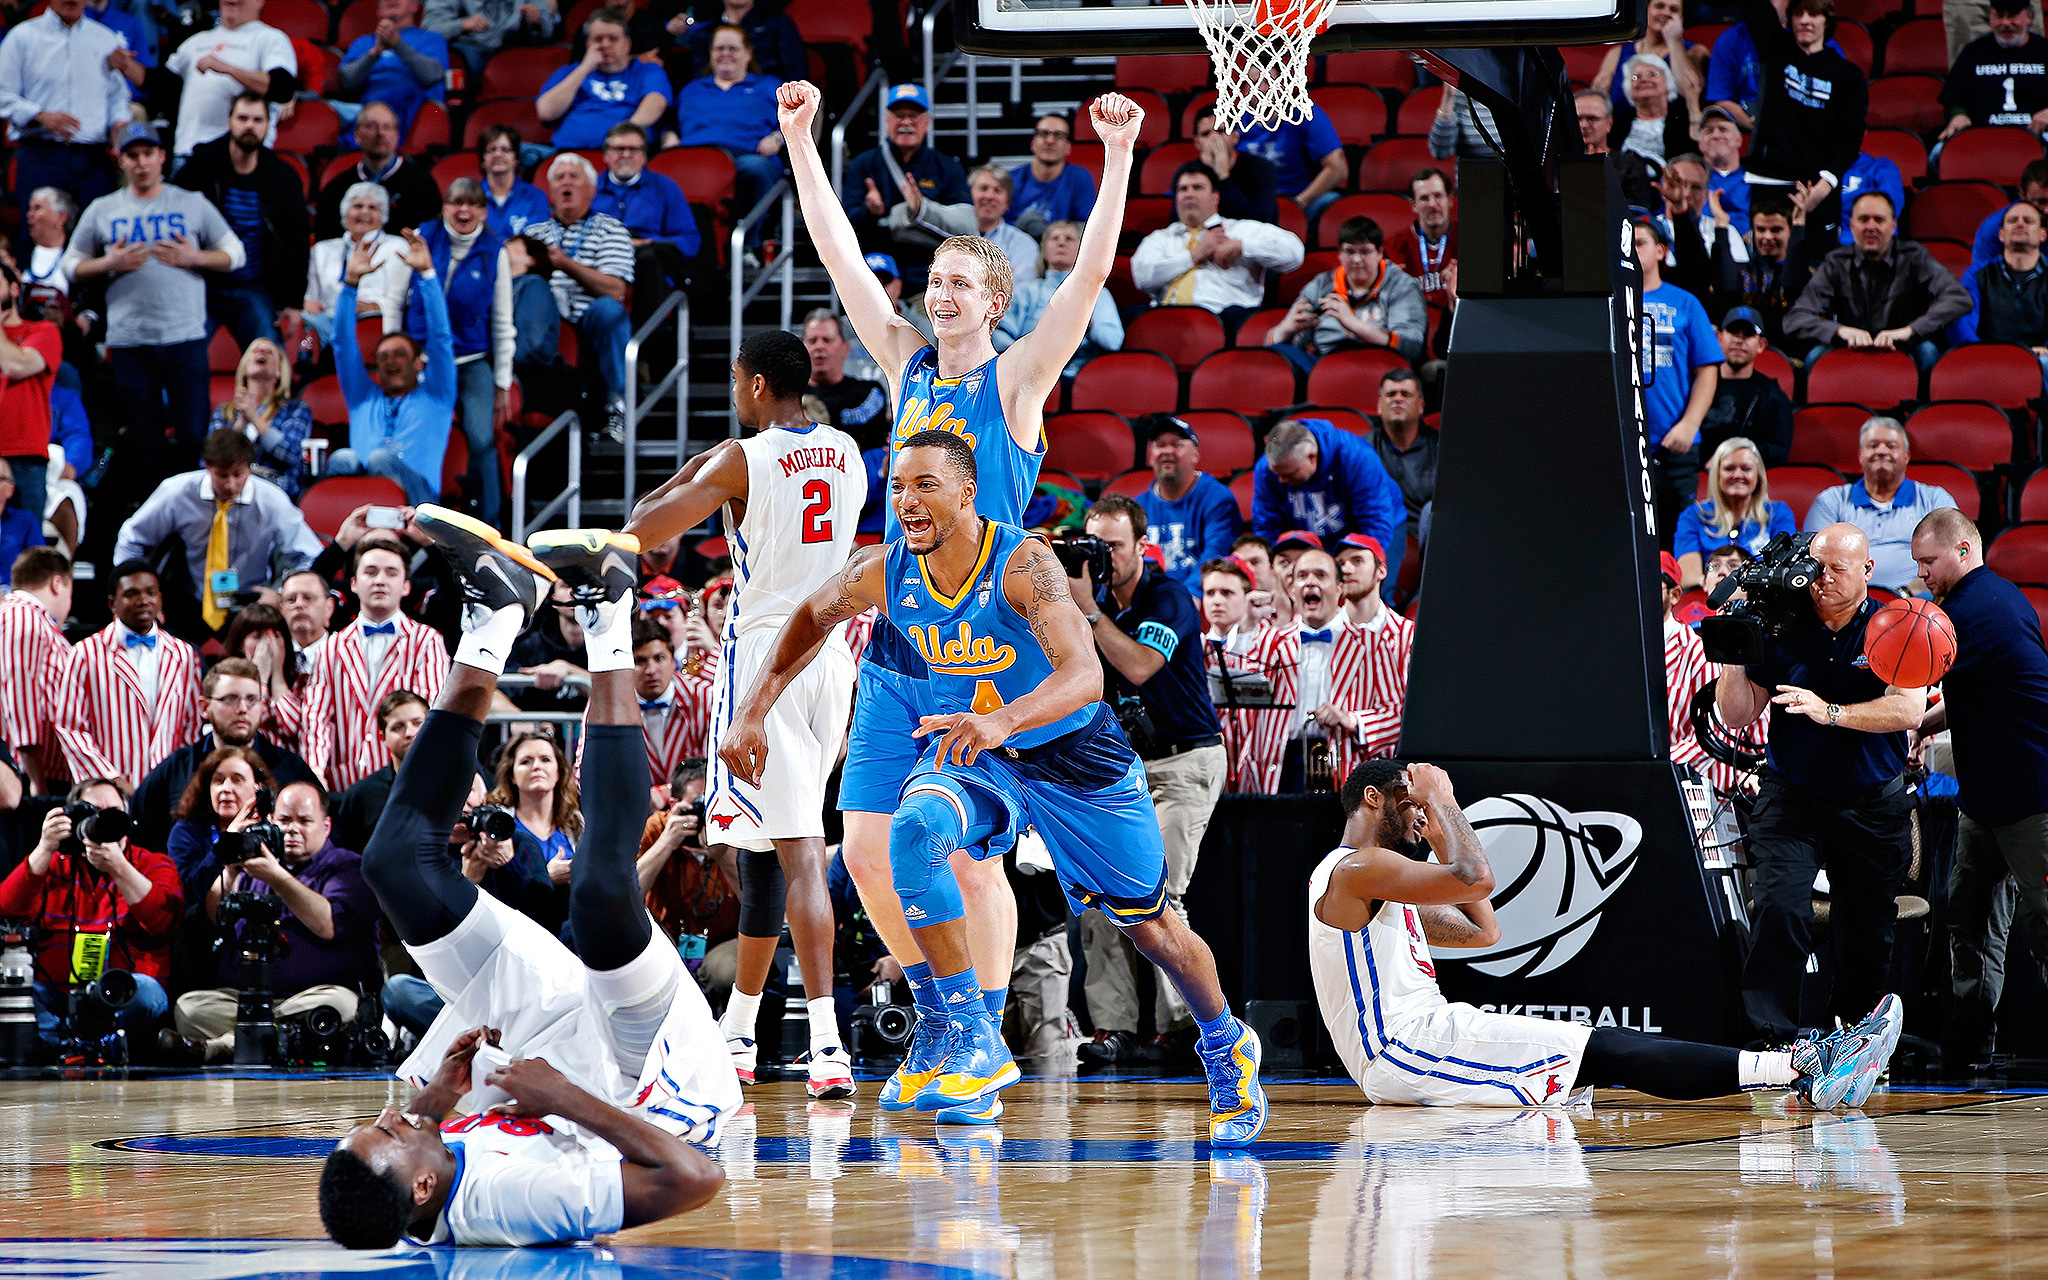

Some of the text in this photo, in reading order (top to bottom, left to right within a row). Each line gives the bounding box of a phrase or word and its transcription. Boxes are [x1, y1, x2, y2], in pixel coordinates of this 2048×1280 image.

[1975, 63, 2046, 76] UTAH STATE
[2002, 77, 2018, 111] 1
[112, 213, 185, 244] CATS
[777, 447, 846, 479] MOREIRA
[801, 478, 834, 545] 2
[908, 621, 1017, 676] Ucla
[969, 679, 1006, 716] 4
